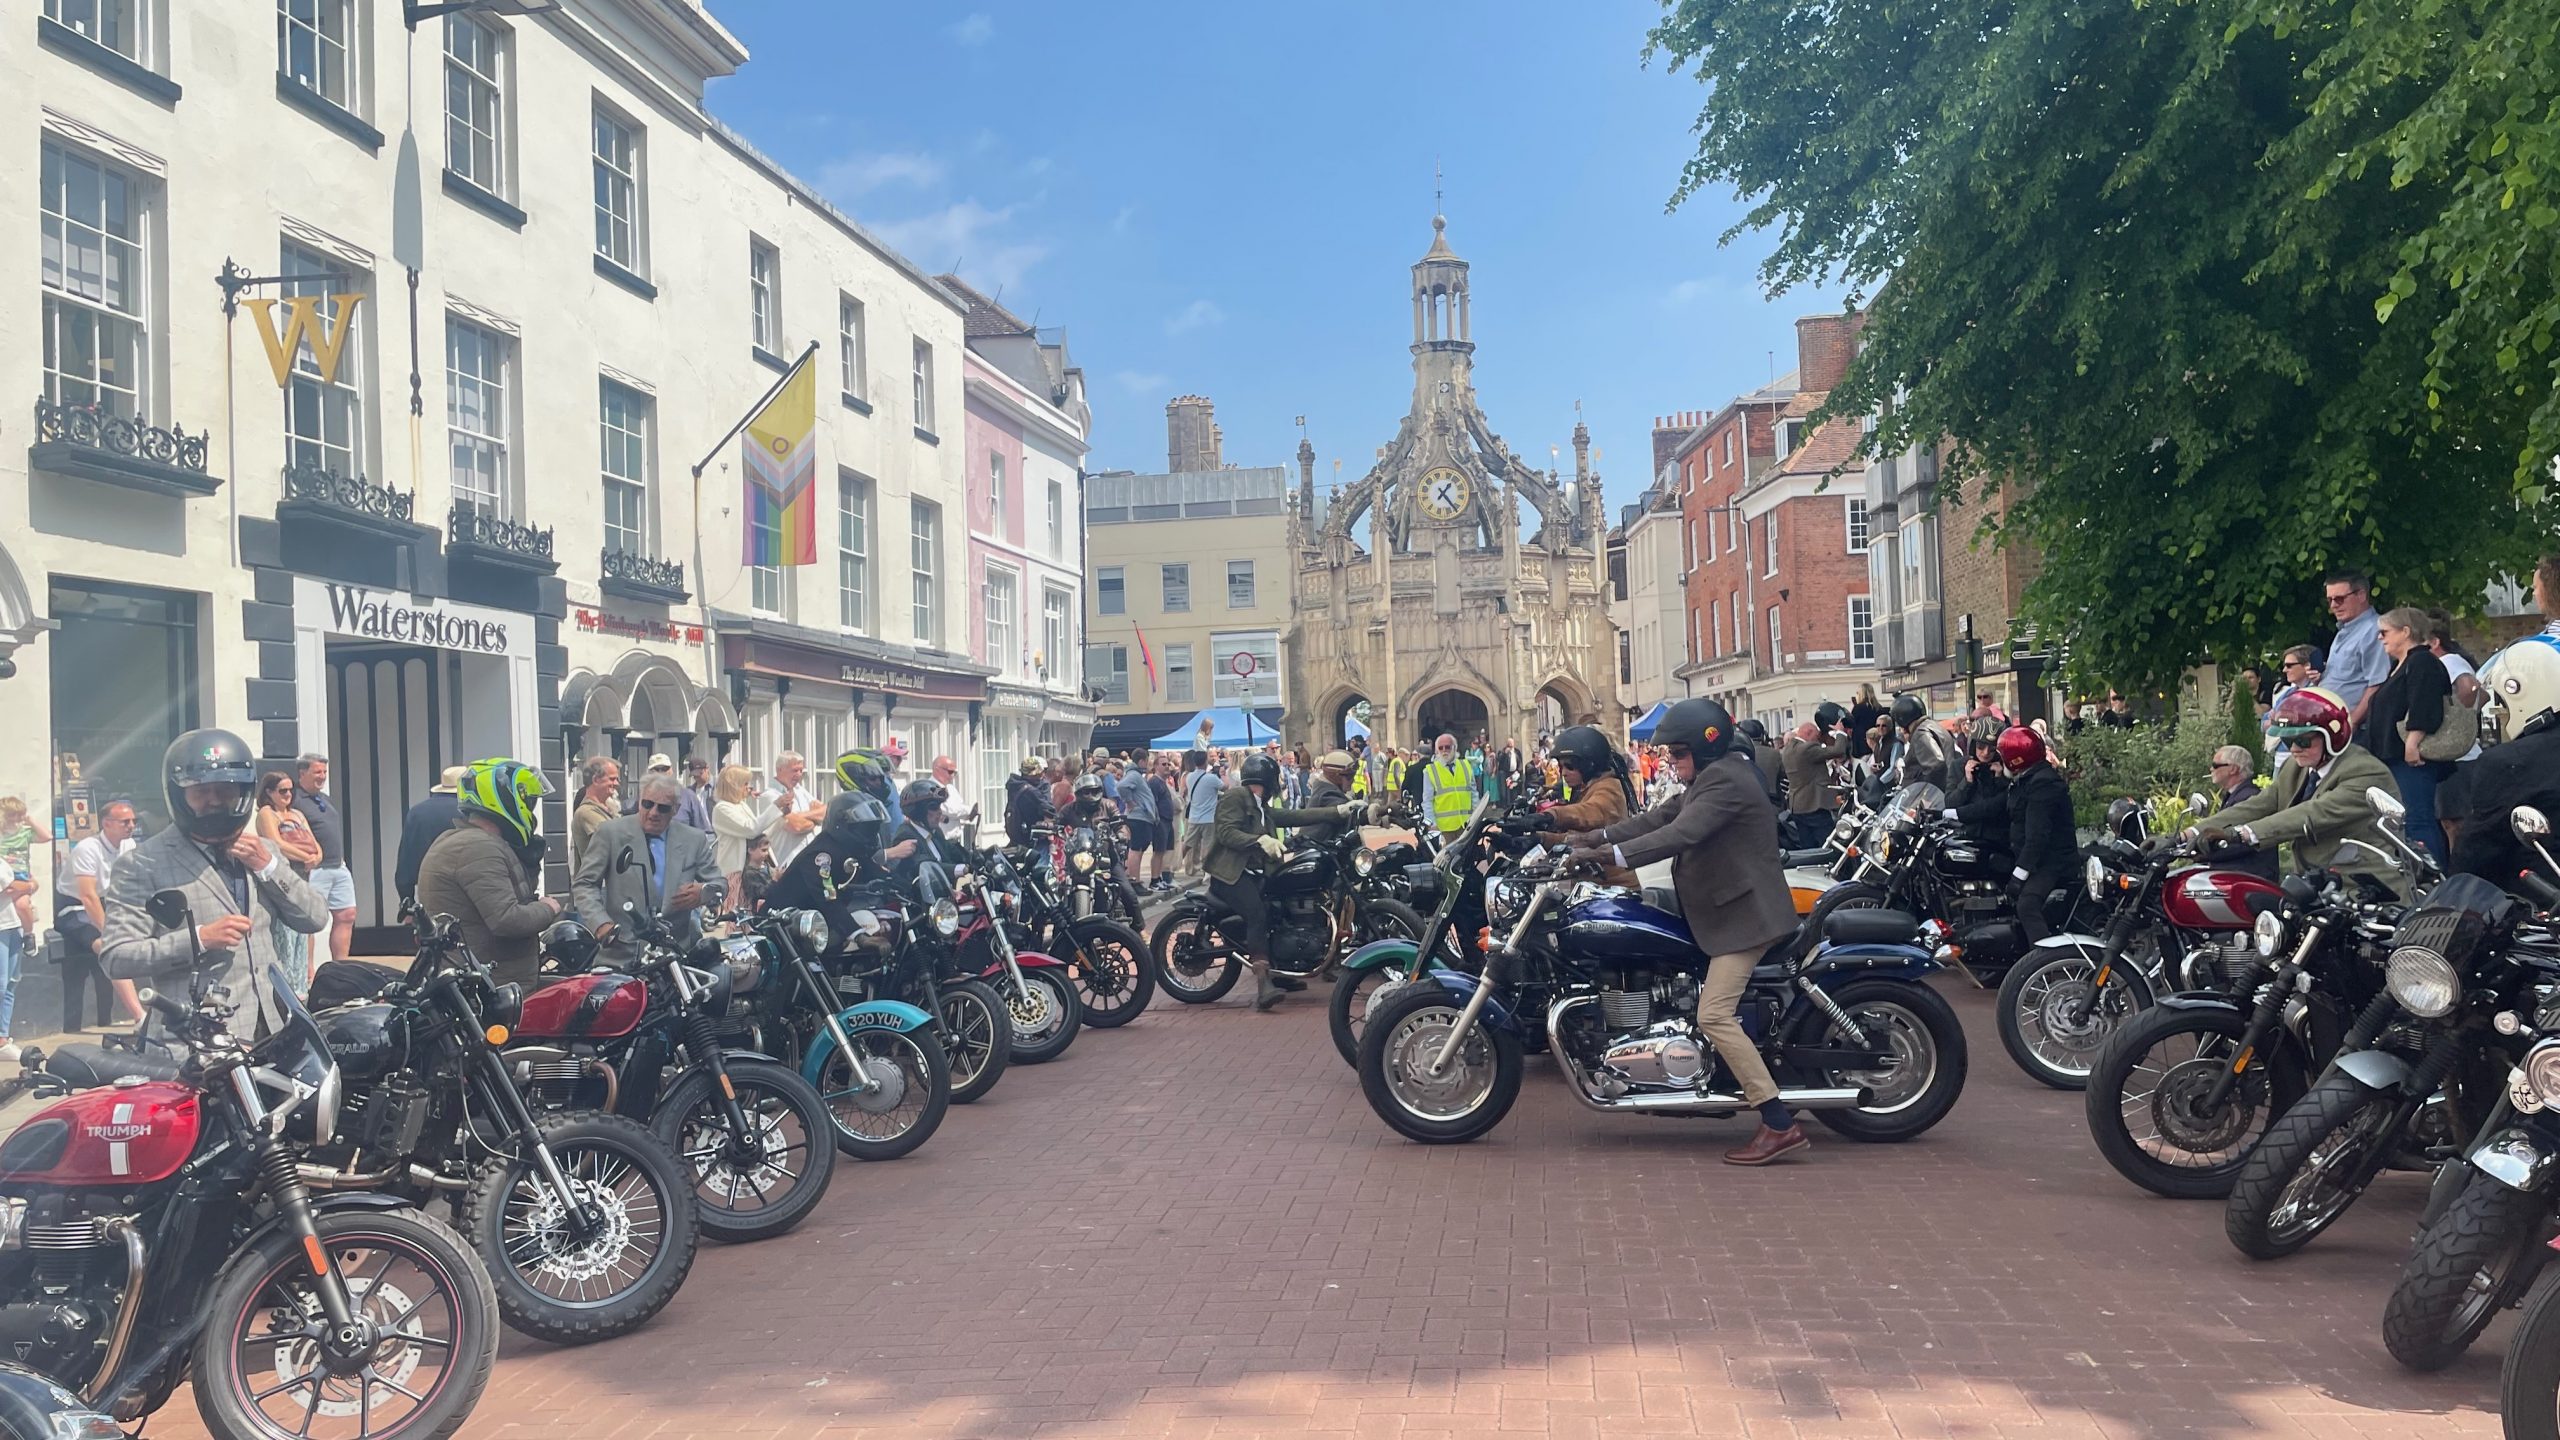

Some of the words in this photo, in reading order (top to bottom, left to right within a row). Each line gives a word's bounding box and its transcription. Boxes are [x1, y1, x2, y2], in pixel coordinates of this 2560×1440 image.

[241, 293, 367, 388] W
[326, 583, 507, 652] Waterstones
[575, 609, 599, 627] The
[685, 626, 704, 643] Mill
[842, 665, 854, 680] The
[855, 667, 888, 688] Edinburgh
[889, 671, 913, 687] Woollen
[913, 674, 925, 689] Mill
[848, 1013, 875, 1028] 320
[877, 1012, 903, 1029] YUH
[329, 1043, 369, 1055] ERALD
[87, 1124, 152, 1140] TRIUMPH
